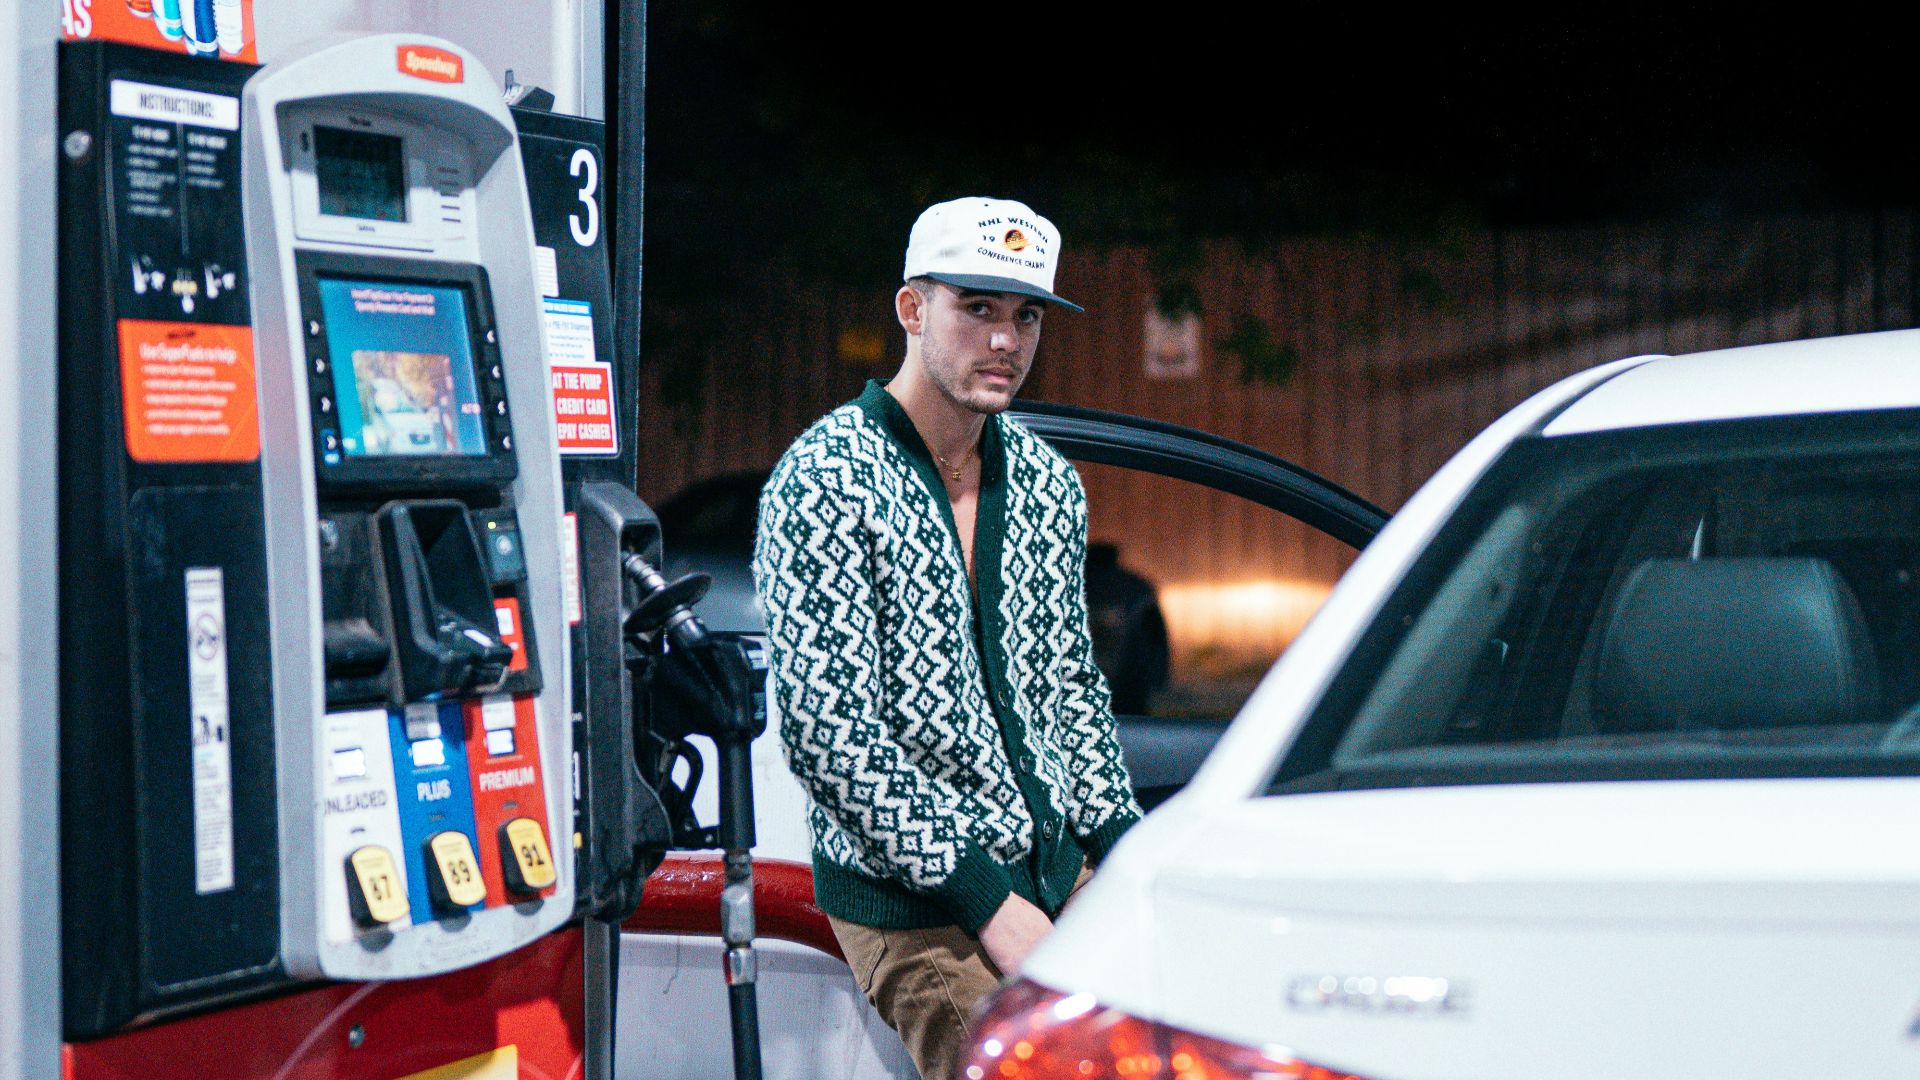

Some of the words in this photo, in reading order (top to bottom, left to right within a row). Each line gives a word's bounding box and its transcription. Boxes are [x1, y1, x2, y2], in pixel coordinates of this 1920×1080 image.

[405, 50, 457, 80] Speedway
[569, 148, 599, 247] 3
[978, 217, 1002, 228] NHL
[1007, 217, 1049, 244] WESTERN
[977, 247, 1023, 266] CONFERENCE
[563, 372, 579, 389] THE
[579, 373, 602, 390] PUMP
[557, 397, 585, 415] CREDIT
[585, 398, 608, 415] CARD
[578, 423, 611, 440] CASHIER
[416, 779, 451, 801] PLUS
[479, 765, 535, 792] PREMIUM
[521, 844, 545, 868] 91
[447, 860, 471, 885] 89
[369, 874, 392, 901] 87
